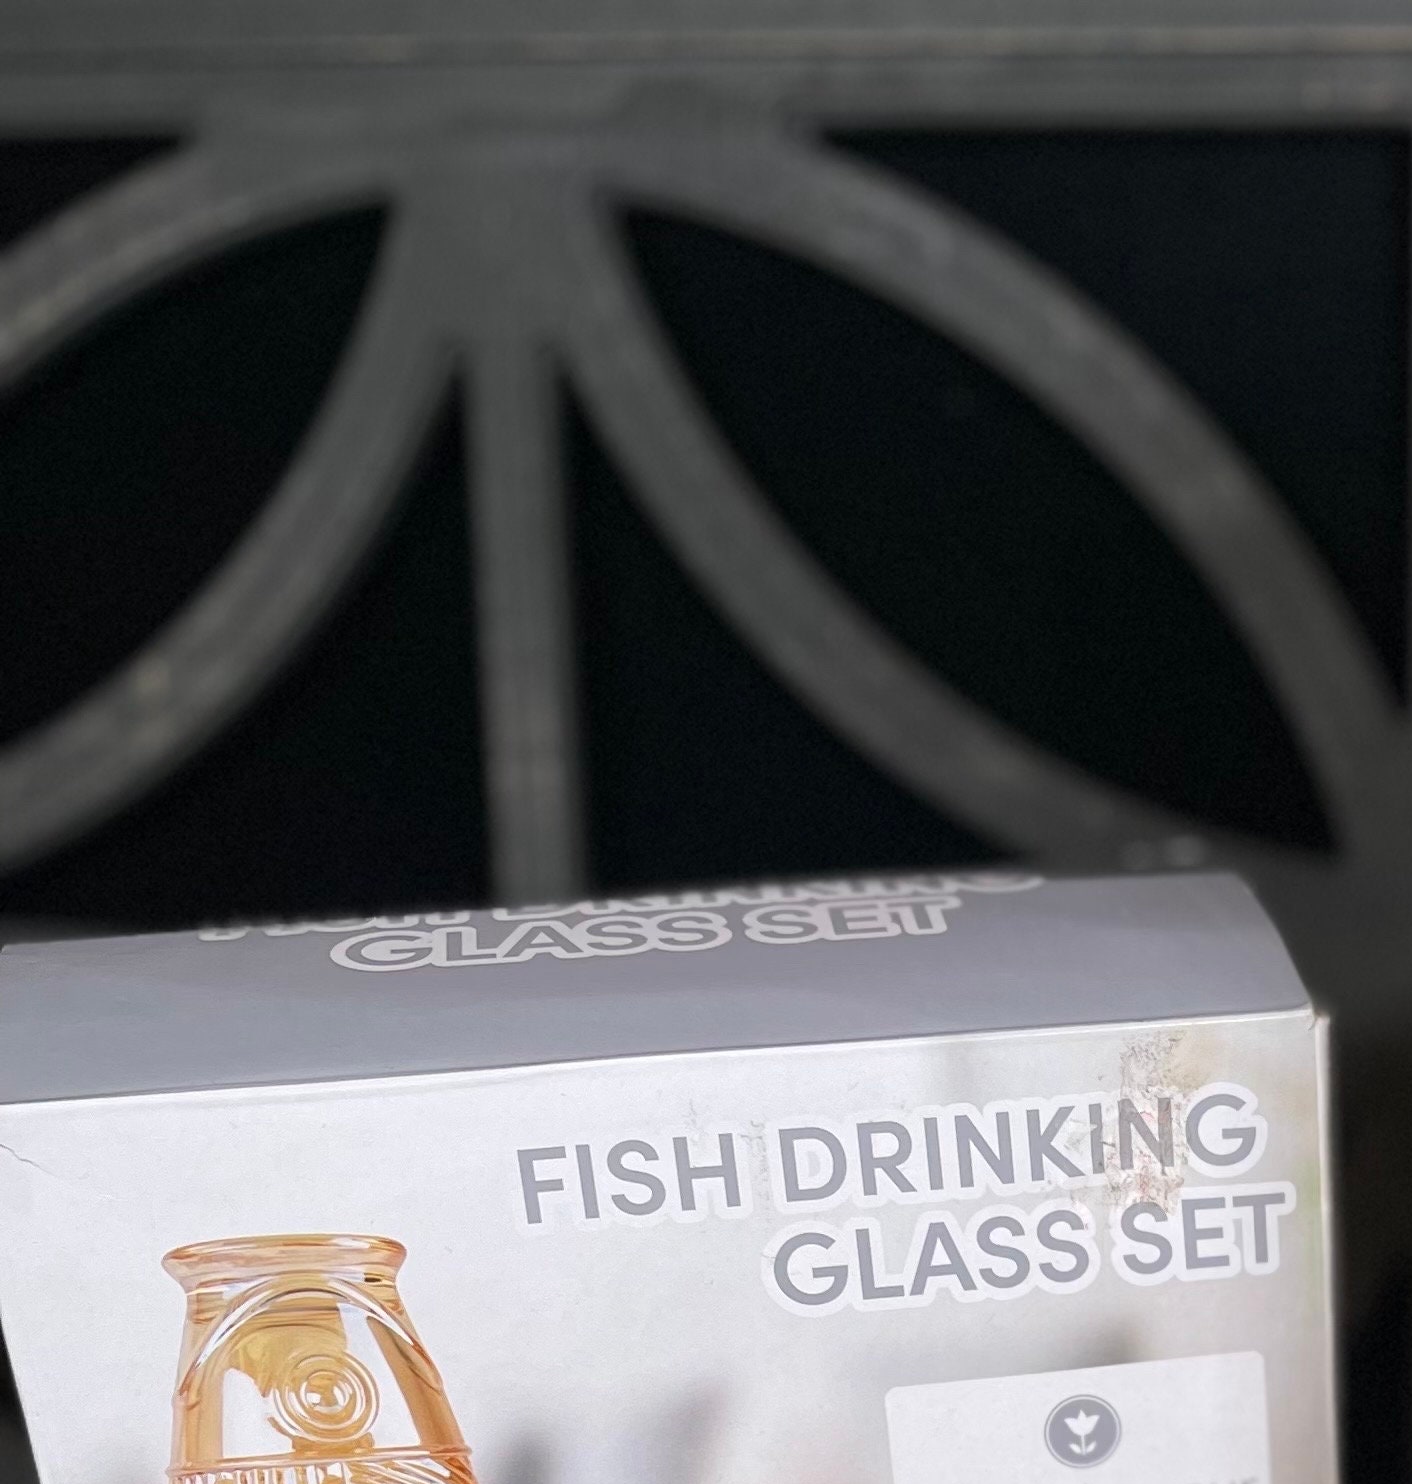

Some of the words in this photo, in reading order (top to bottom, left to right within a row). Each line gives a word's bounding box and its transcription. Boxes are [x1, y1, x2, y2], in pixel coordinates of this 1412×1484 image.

[335, 911, 728, 970] GLASS
[748, 897, 956, 943] SET
[516, 1131, 742, 1225] FISH
[777, 1092, 1257, 1203] DRINKING
[773, 1204, 1090, 1306] GLASS
[1120, 1192, 1286, 1276] SET
